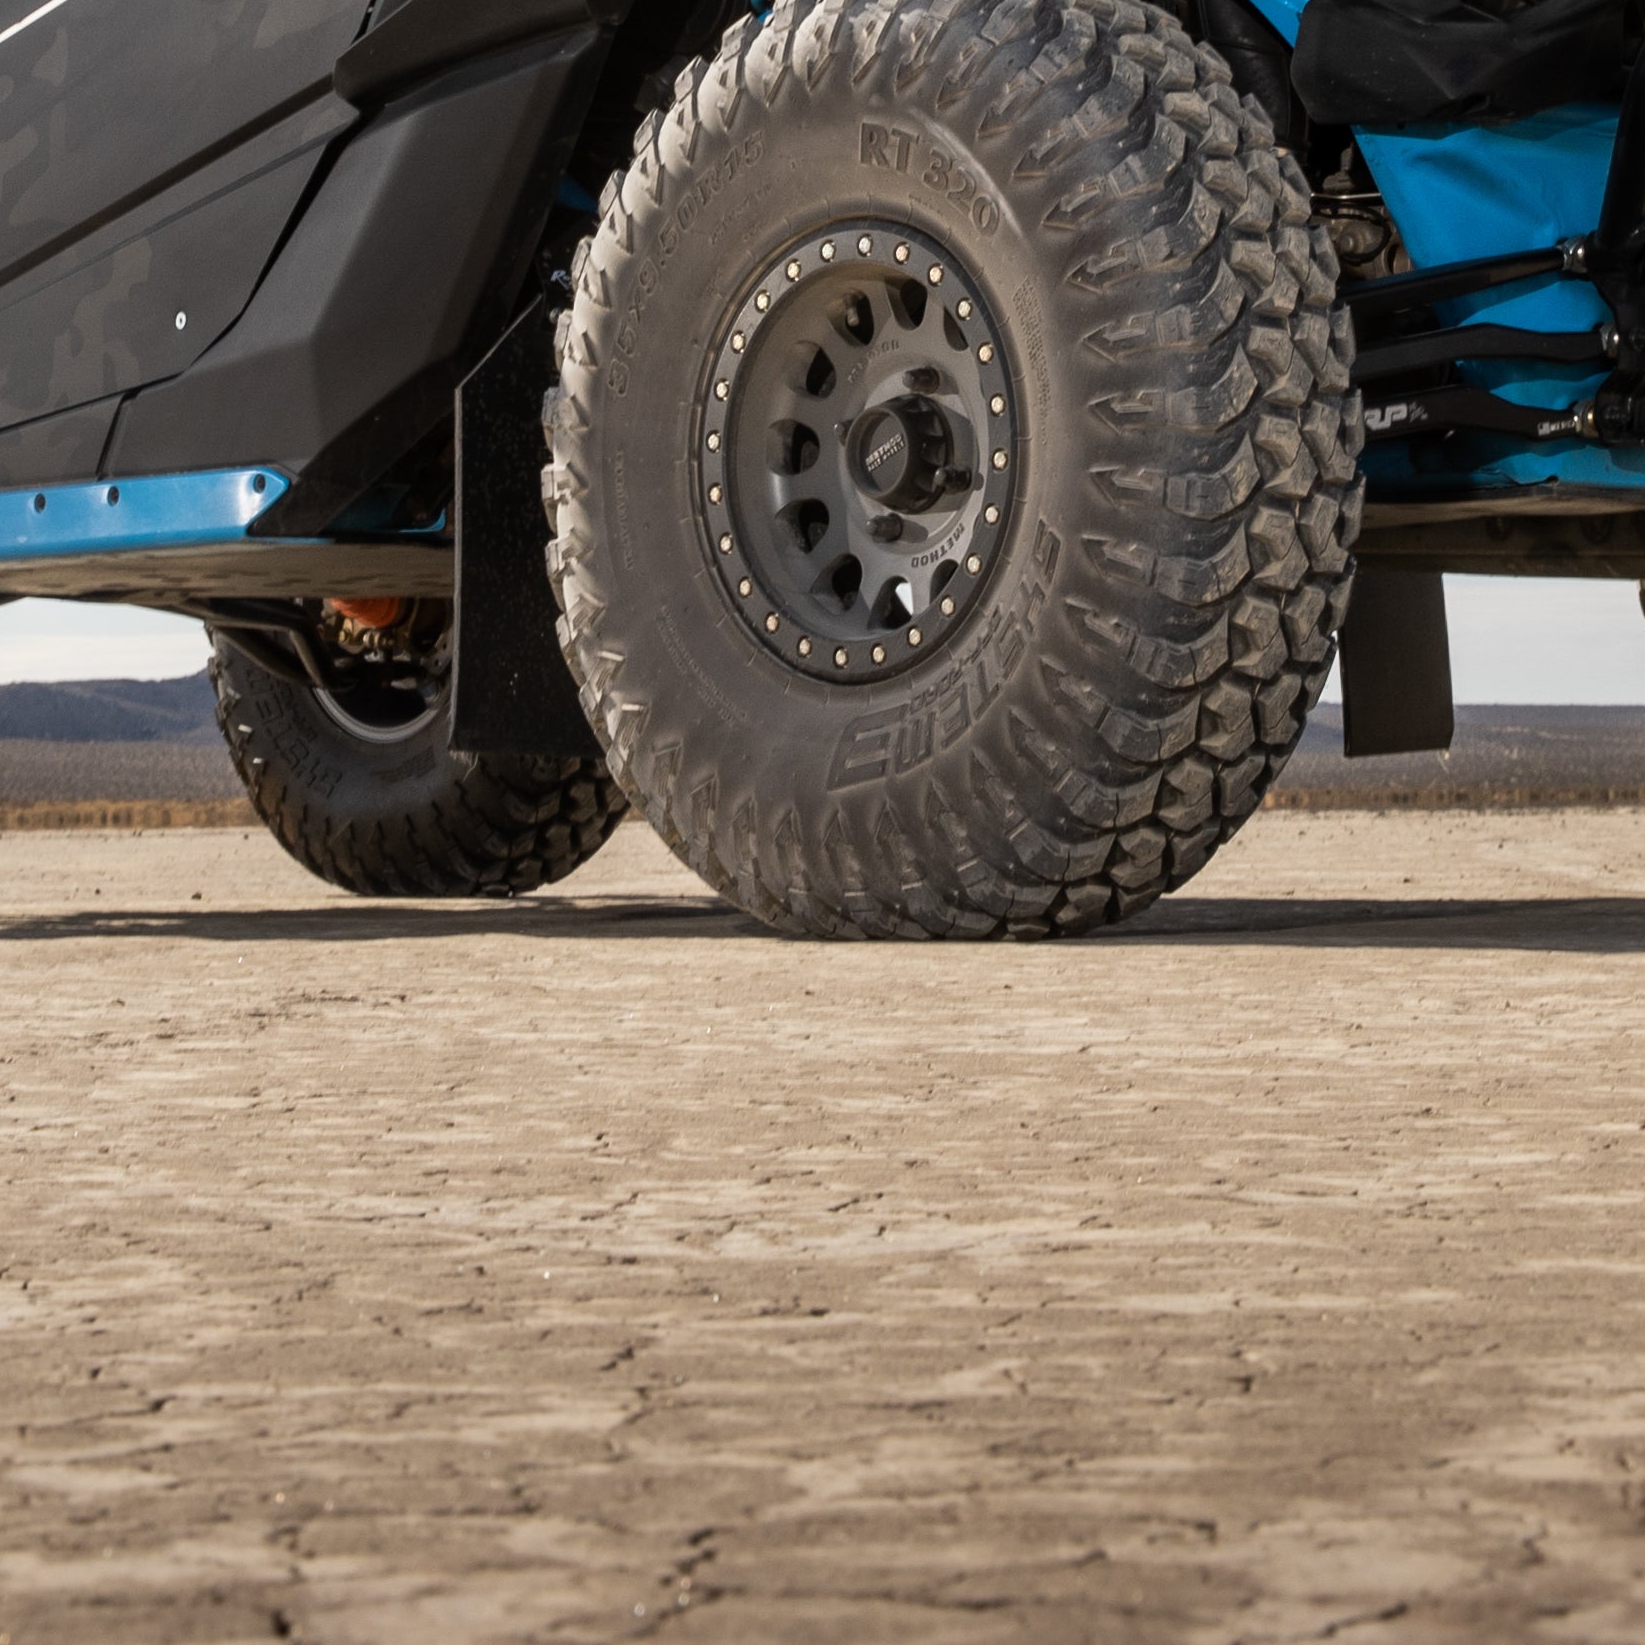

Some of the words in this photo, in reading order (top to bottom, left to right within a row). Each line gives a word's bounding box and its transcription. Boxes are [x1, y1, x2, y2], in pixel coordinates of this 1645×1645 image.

[859, 121, 922, 172] RT
[922, 144, 1002, 238] 320
[865, 432, 903, 464] METHOD
[910, 522, 965, 569] METHOD
